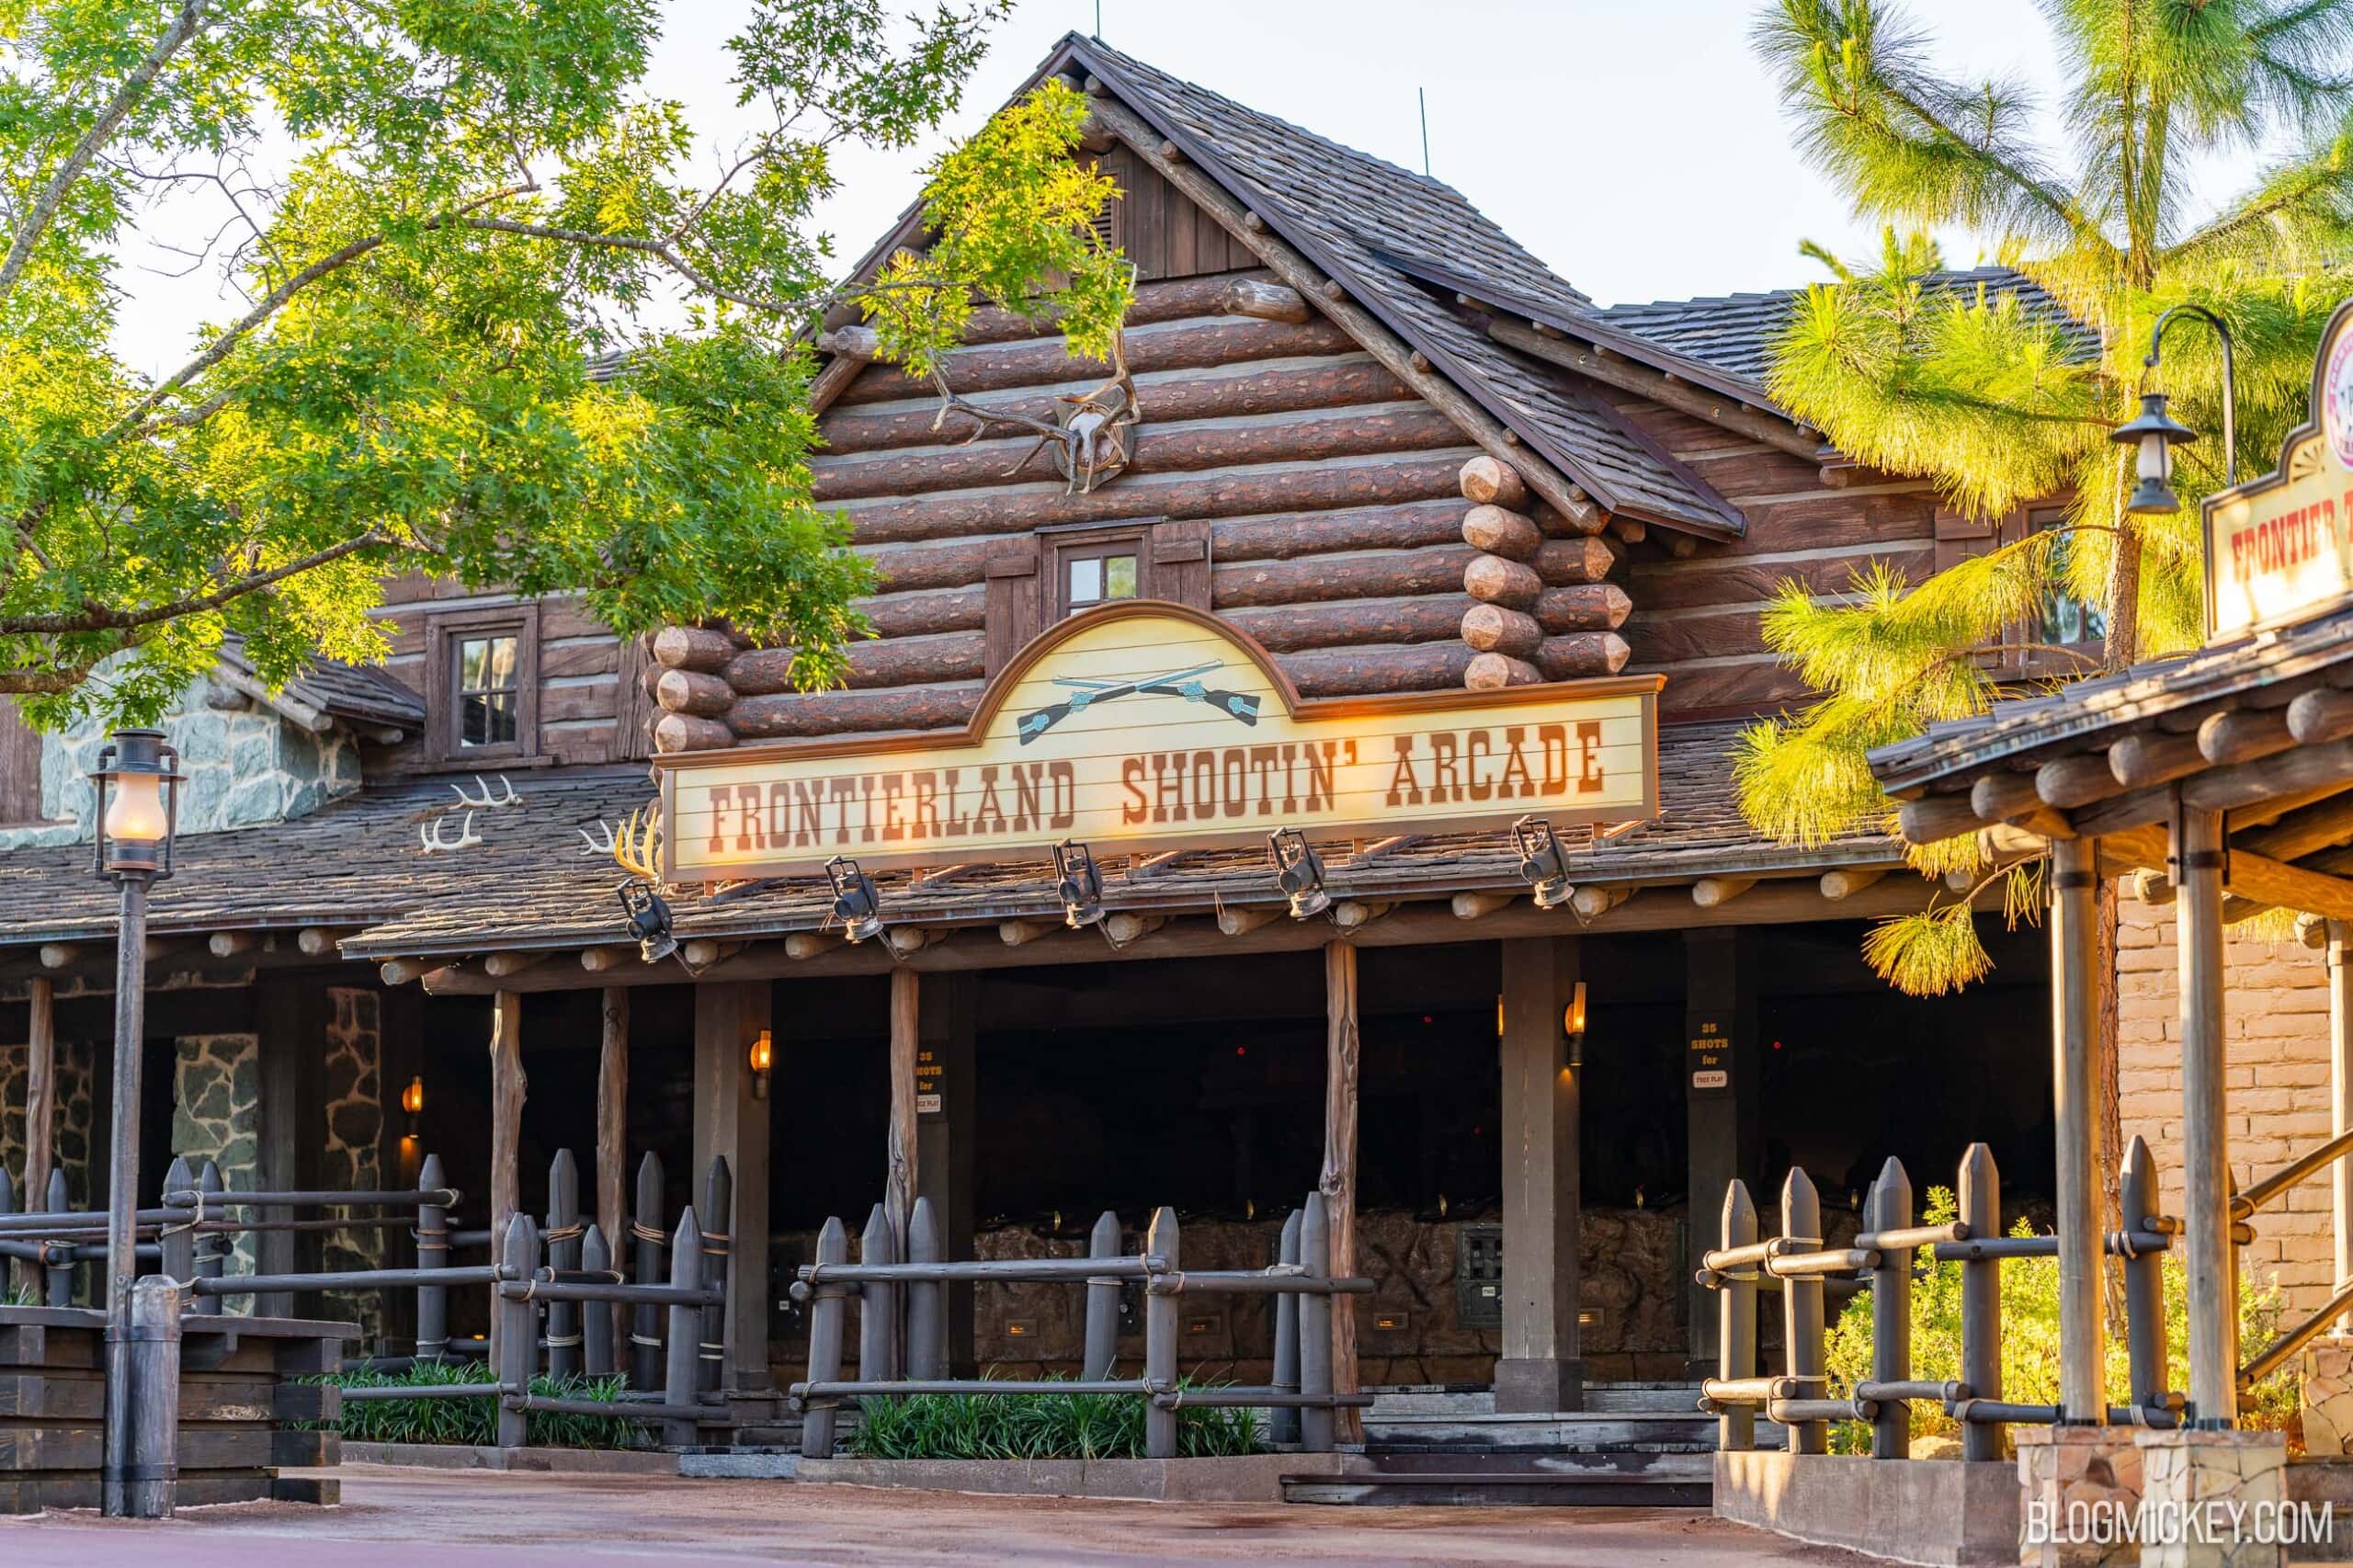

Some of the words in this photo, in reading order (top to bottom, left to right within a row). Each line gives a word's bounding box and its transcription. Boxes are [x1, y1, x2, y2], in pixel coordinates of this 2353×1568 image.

[2231, 497, 2337, 584] FRONTIER
[709, 760, 1075, 854] FRONTIERLAND
[1121, 739, 1358, 826] SHOOTIN'
[1385, 721, 1605, 809] ARCADE
[1691, 1039, 1728, 1050] SHOTS
[1702, 1055, 1718, 1065] for
[915, 1066, 941, 1075] HOTS
[919, 1082, 933, 1090] for
